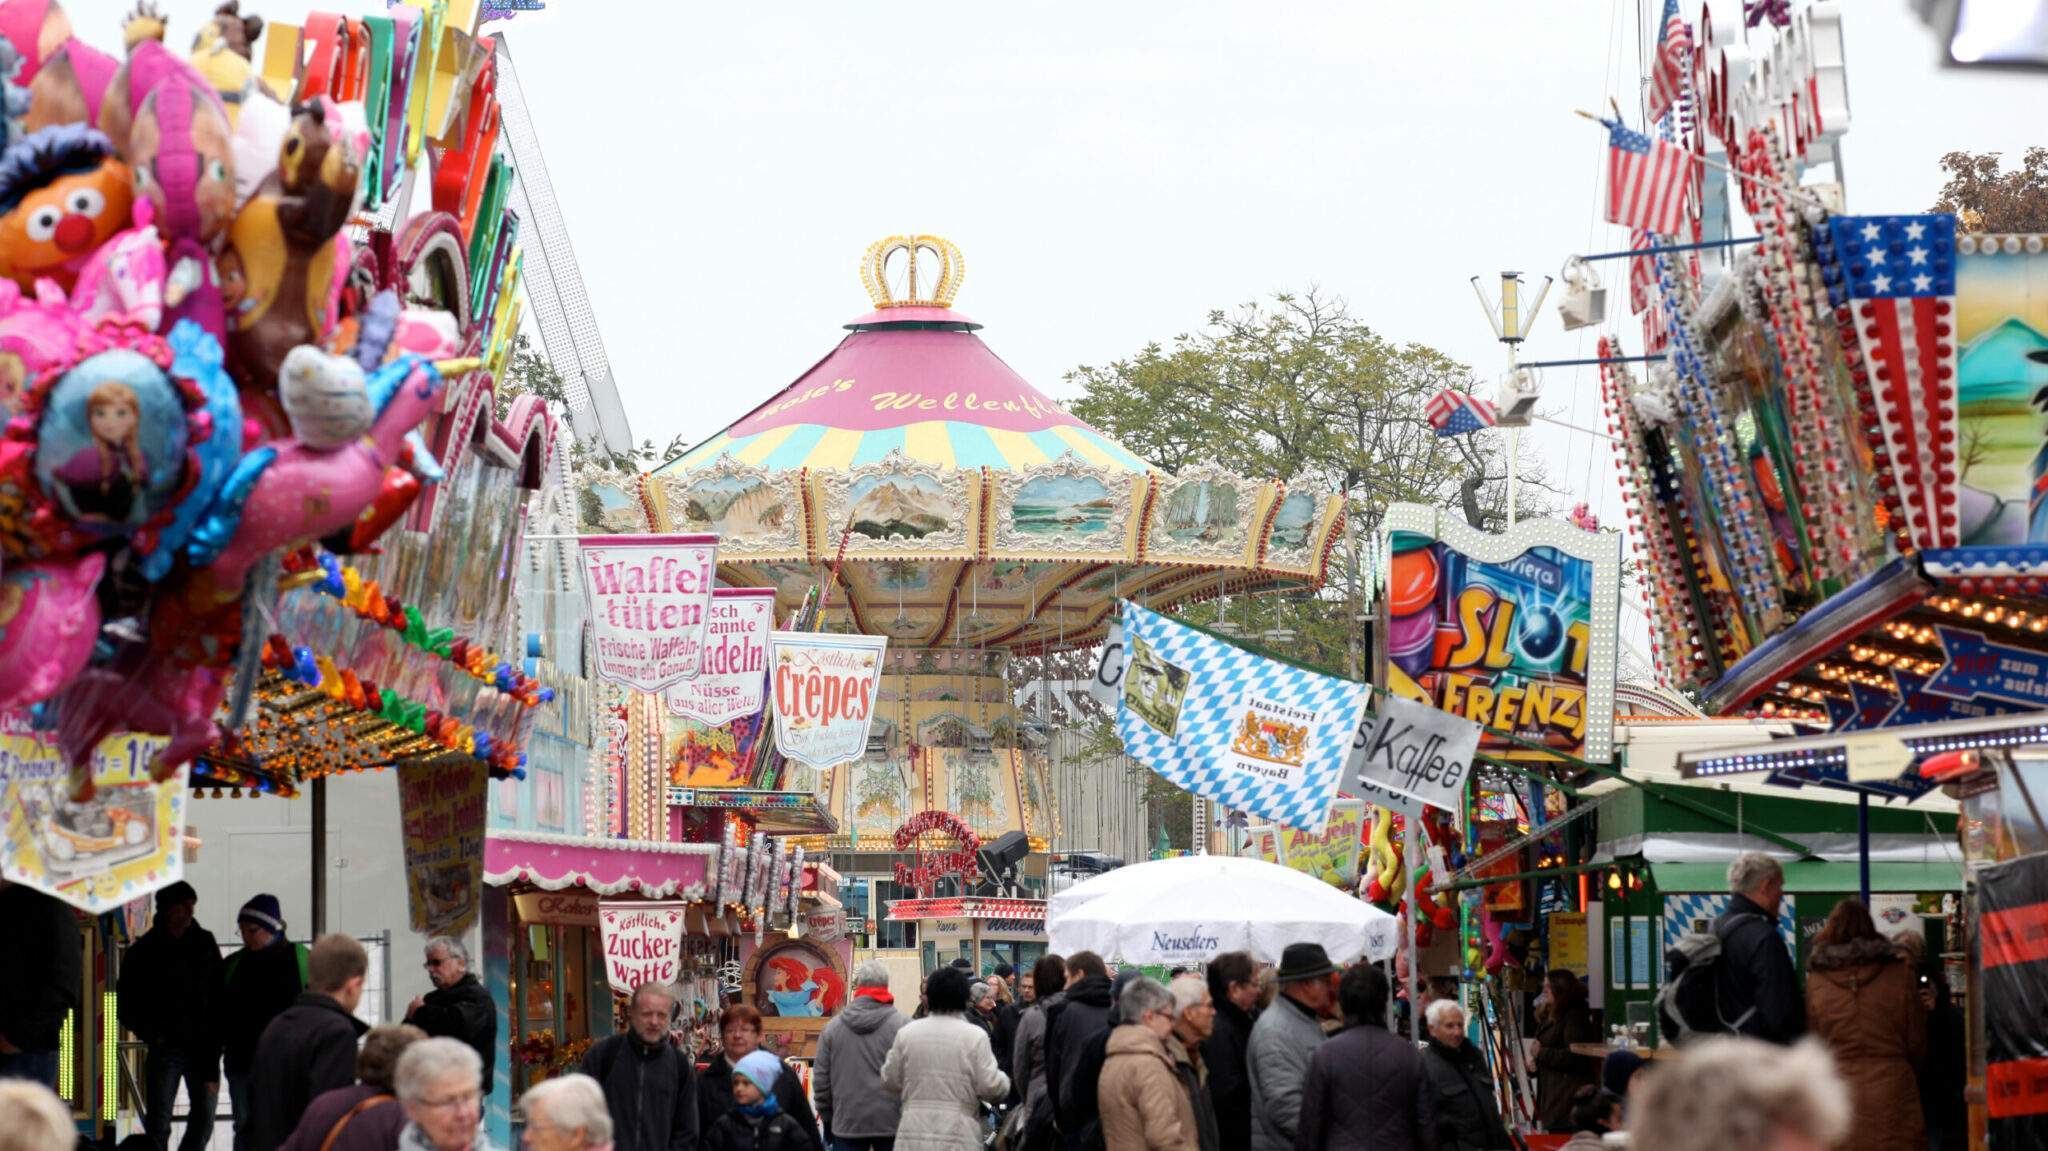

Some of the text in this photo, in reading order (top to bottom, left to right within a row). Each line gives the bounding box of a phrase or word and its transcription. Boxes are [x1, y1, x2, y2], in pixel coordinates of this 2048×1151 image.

[590, 555, 711, 596] Waffel
[711, 604, 739, 619] sch
[709, 620, 757, 635] annte
[600, 637, 647, 661] Frische
[701, 634, 764, 676] ndeln
[603, 659, 638, 681] Immer
[775, 664, 873, 728] Crêpes
[1366, 716, 1464, 793] Kaffee
[619, 911, 667, 932] Köstliche
[607, 930, 678, 960] Zucker-
[1151, 924, 1220, 951] Neuselters
